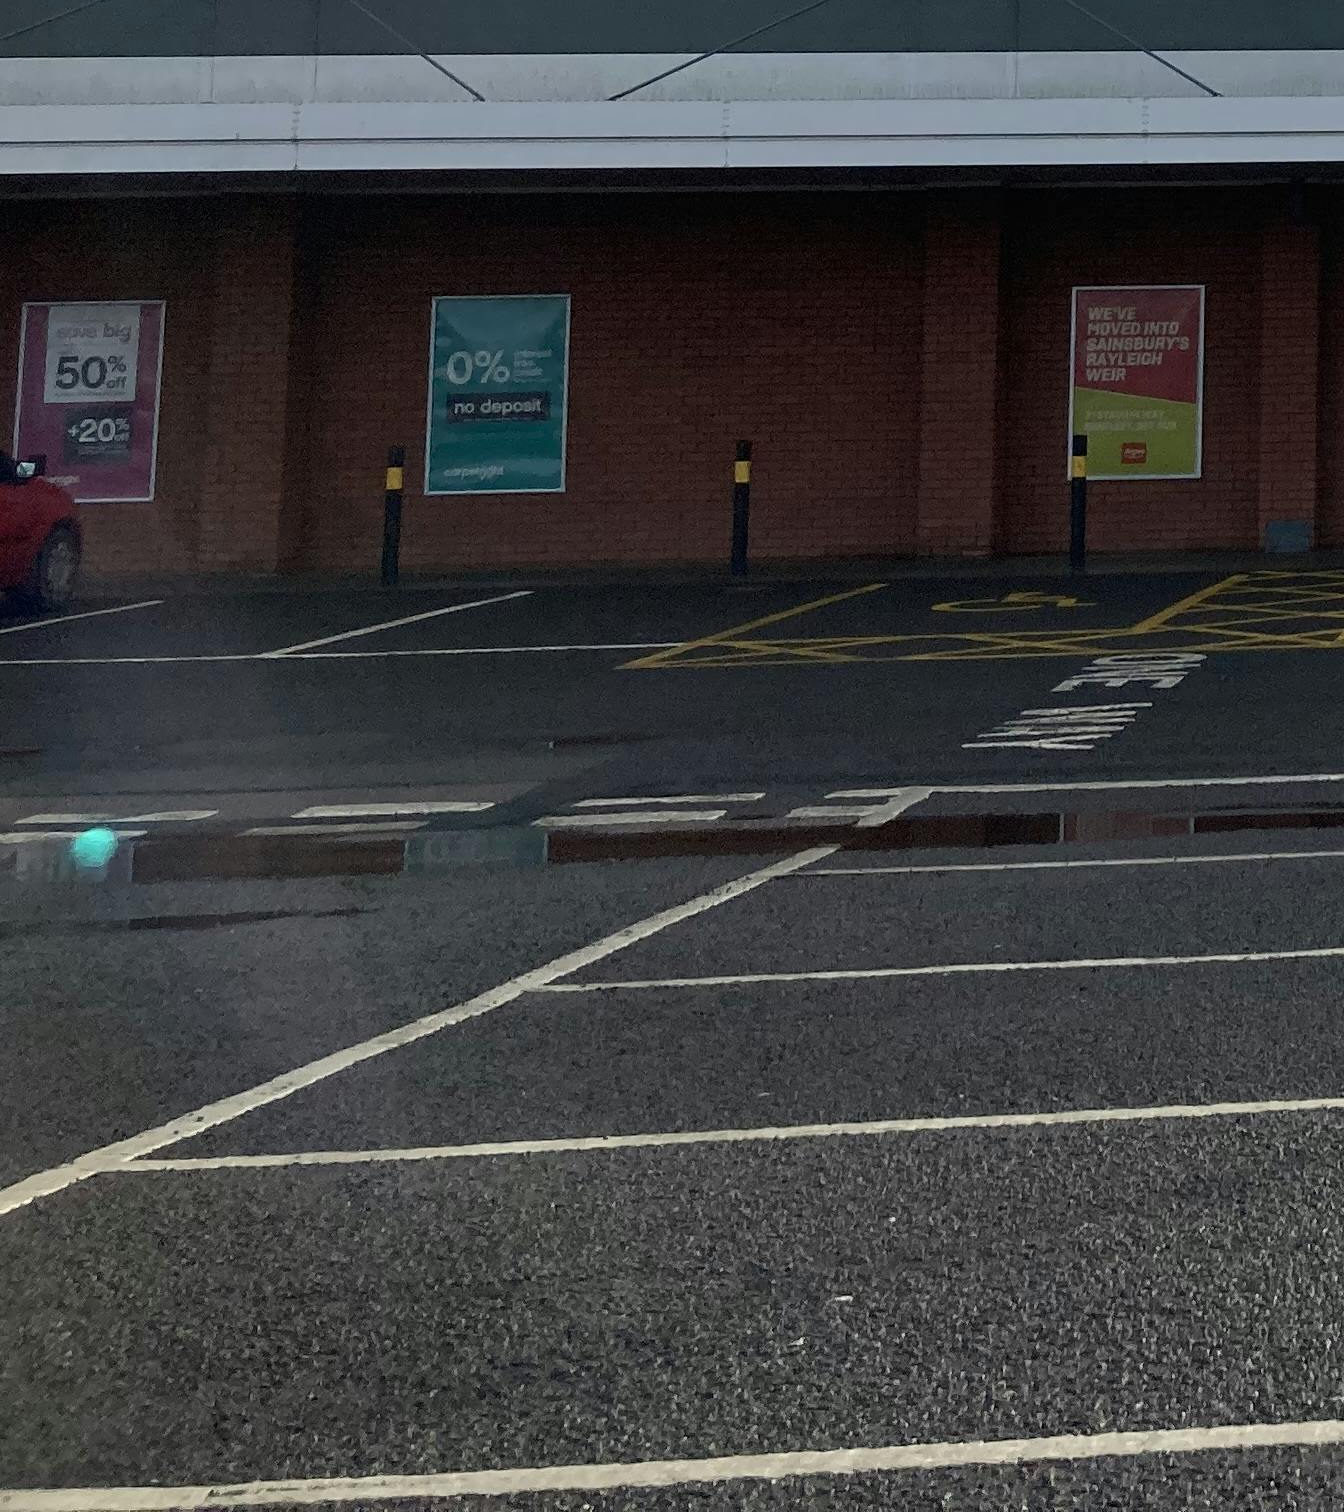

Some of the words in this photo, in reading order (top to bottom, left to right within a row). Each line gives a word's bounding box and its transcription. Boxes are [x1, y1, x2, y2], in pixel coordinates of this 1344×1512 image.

[1088, 307, 1136, 321] WE'VE
[103, 321, 132, 343] big
[1087, 322, 1142, 336] MOVED
[1144, 321, 1179, 335] INTO
[1086, 336, 1189, 352] SAINSBURY'S
[446, 349, 511, 385] 0%
[1086, 352, 1162, 366] RAYLEIGH
[55, 355, 127, 390] 50%
[1086, 367, 1126, 382] WEIR
[106, 376, 127, 389] off
[454, 402, 475, 415] no
[479, 399, 543, 416] deposit
[67, 417, 130, 443] +20%
